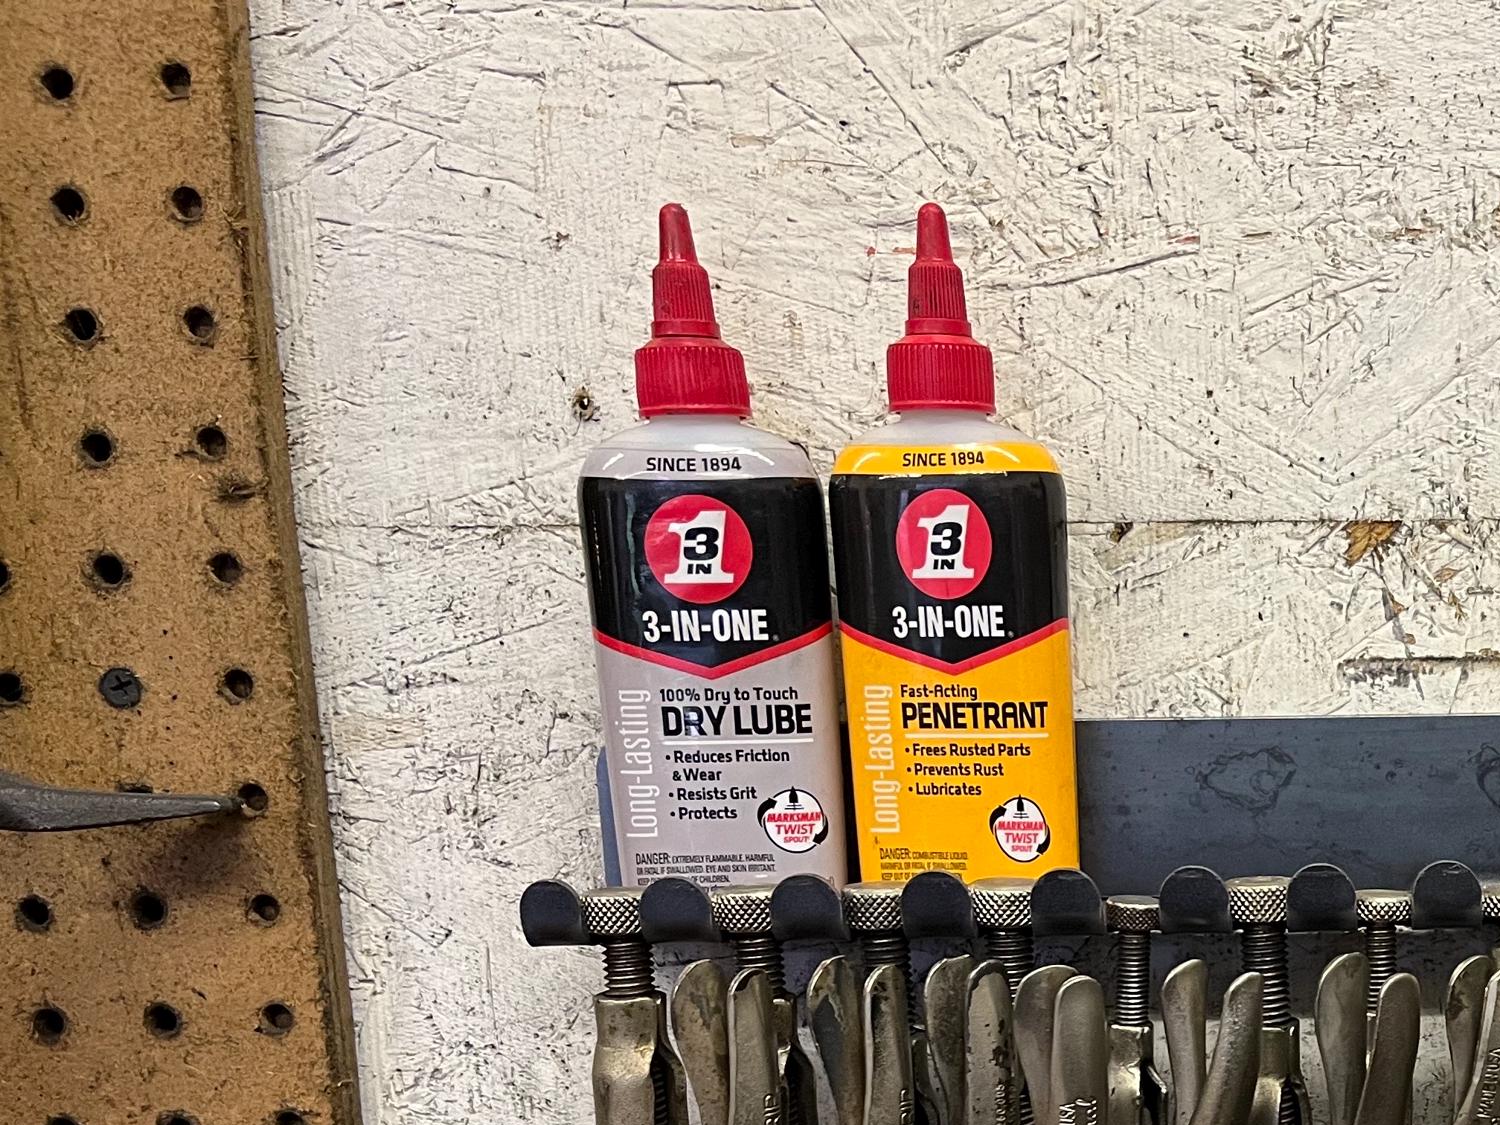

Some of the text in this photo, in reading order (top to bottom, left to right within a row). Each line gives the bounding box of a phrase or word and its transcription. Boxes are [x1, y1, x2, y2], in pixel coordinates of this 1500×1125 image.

[646, 456, 742, 472] SINCE 1894
[902, 451, 985, 467] SINCE 1894
[683, 526, 720, 561] 3
[930, 521, 963, 556] 3
[687, 563, 713, 575] IN
[933, 559, 955, 570] IN
[642, 608, 769, 643] 3-IN-ONE
[892, 604, 1006, 639] 3-IN-ONE
[660, 686, 799, 705] 100% Dry to Touch
[901, 684, 978, 701] Fast-Acting
[661, 704, 813, 736] DRY LUBE
[902, 701, 1049, 729] PENETRANT
[674, 749, 790, 763] Reduces Friction
[912, 742, 1031, 757] Frees Rusted Parts
[683, 768, 722, 781] Wear
[914, 762, 1005, 776] Prevents Rust
[677, 786, 758, 801] Resists Grit
[916, 782, 982, 796] Lubricates
[679, 807, 738, 820] Protects
[767, 812, 822, 823] MARKSMAN
[775, 824, 815, 835] TWIST
[998, 821, 1044, 831] MARKSMAN
[1005, 833, 1039, 844] TWIST
[636, 852, 671, 865] DANGER:
[1059, 1103, 1076, 1125] USA
